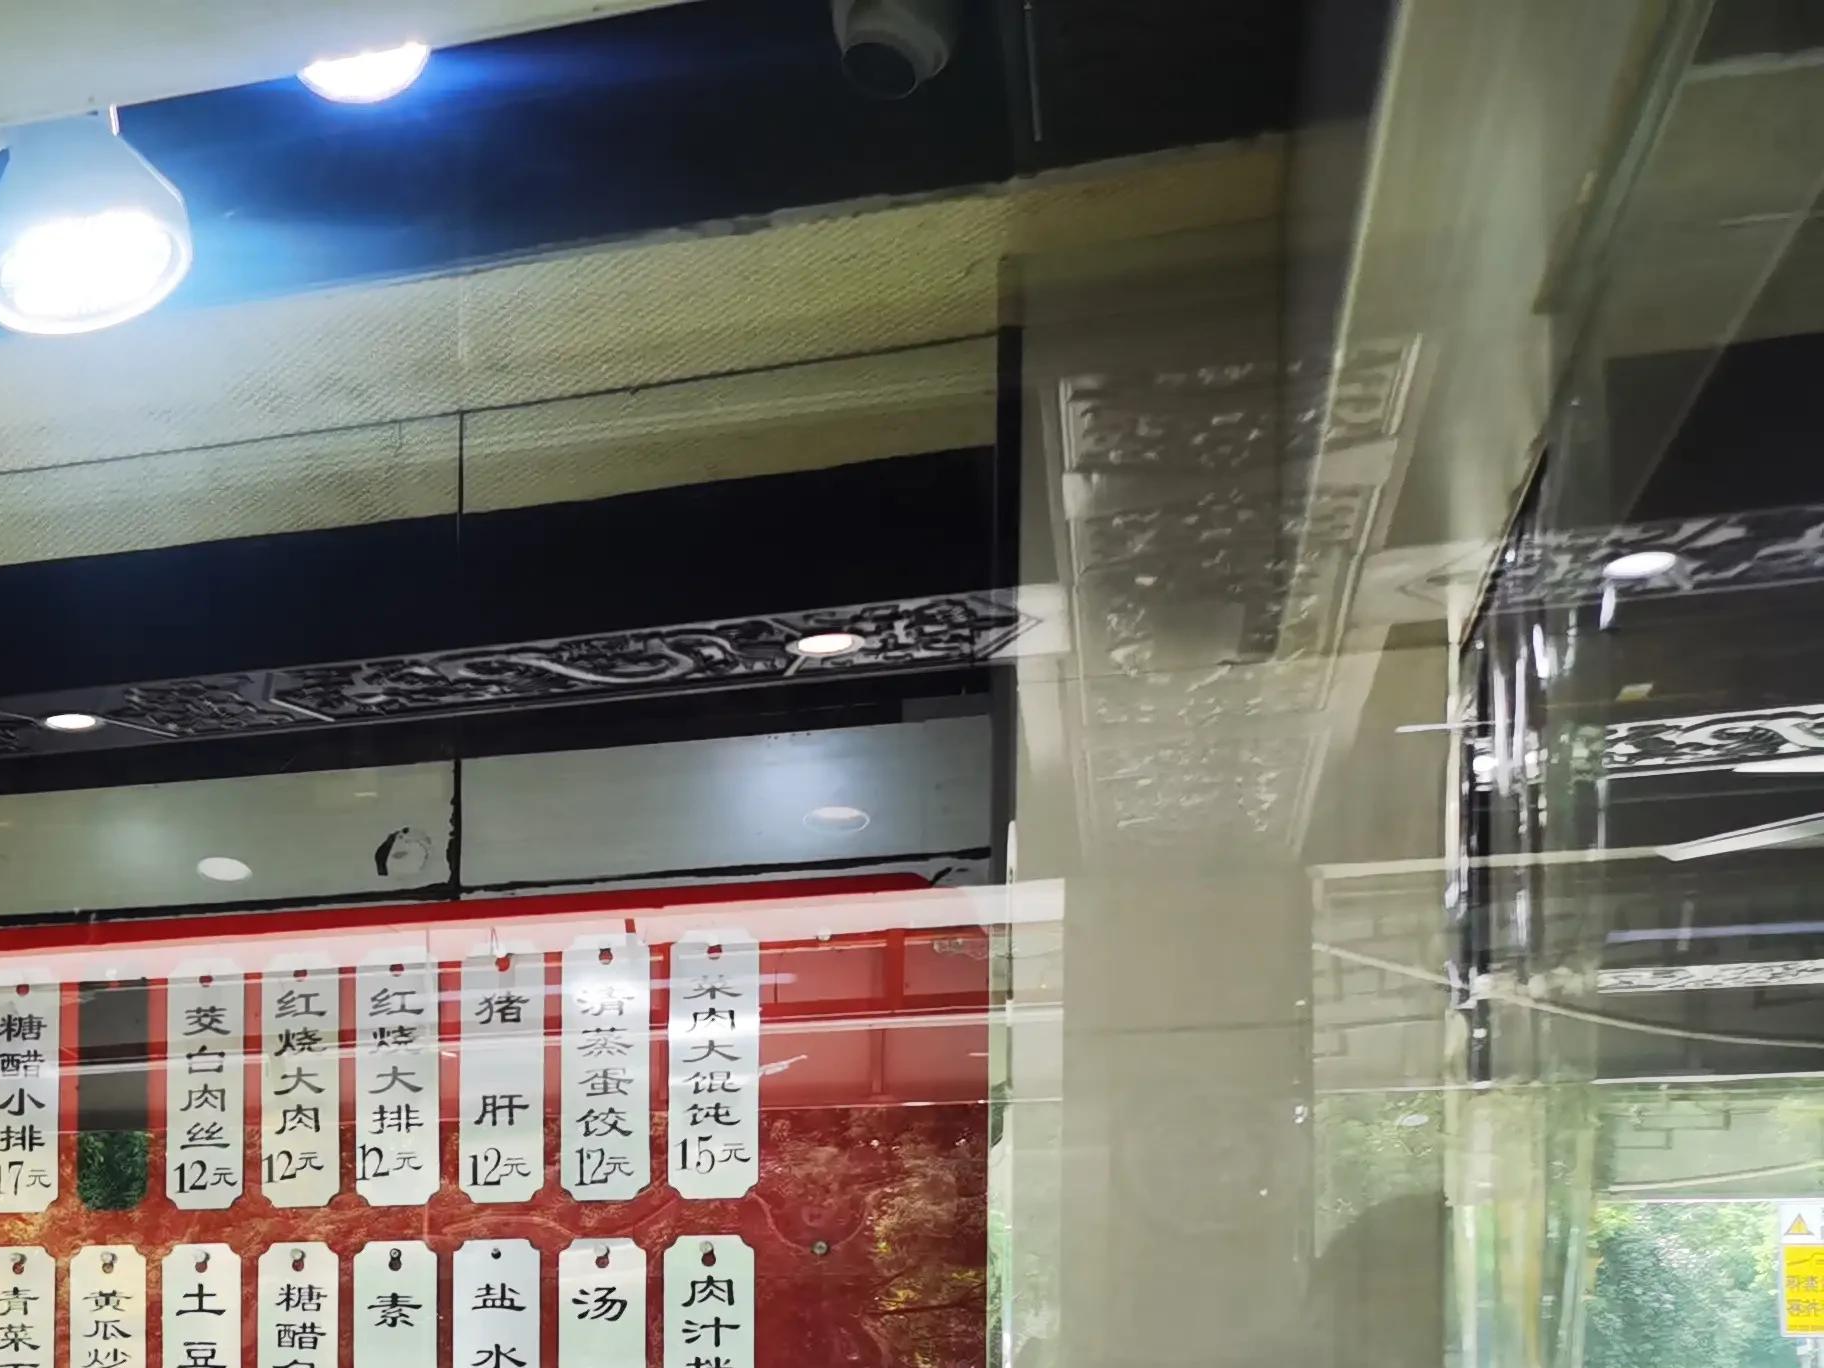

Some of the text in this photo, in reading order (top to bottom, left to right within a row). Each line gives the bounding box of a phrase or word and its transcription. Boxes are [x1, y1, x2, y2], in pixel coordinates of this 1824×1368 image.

[179, 1005, 231, 1150] 茭白肉丝
[274, 990, 327, 1135] 红烧大肉
[368, 988, 424, 1134] 红烧大排
[473, 993, 530, 1127] 猪肝
[575, 986, 634, 1137] 清蒸蛋饺
[682, 974, 744, 1127] 菜肉大馄饨
[174, 1160, 238, 1194] 12元
[262, 1150, 324, 1183] 12元
[356, 1144, 424, 1181] 12元
[467, 1147, 531, 1187] 12元
[575, 1147, 634, 1186] 12元
[674, 1134, 752, 1174] 15元
